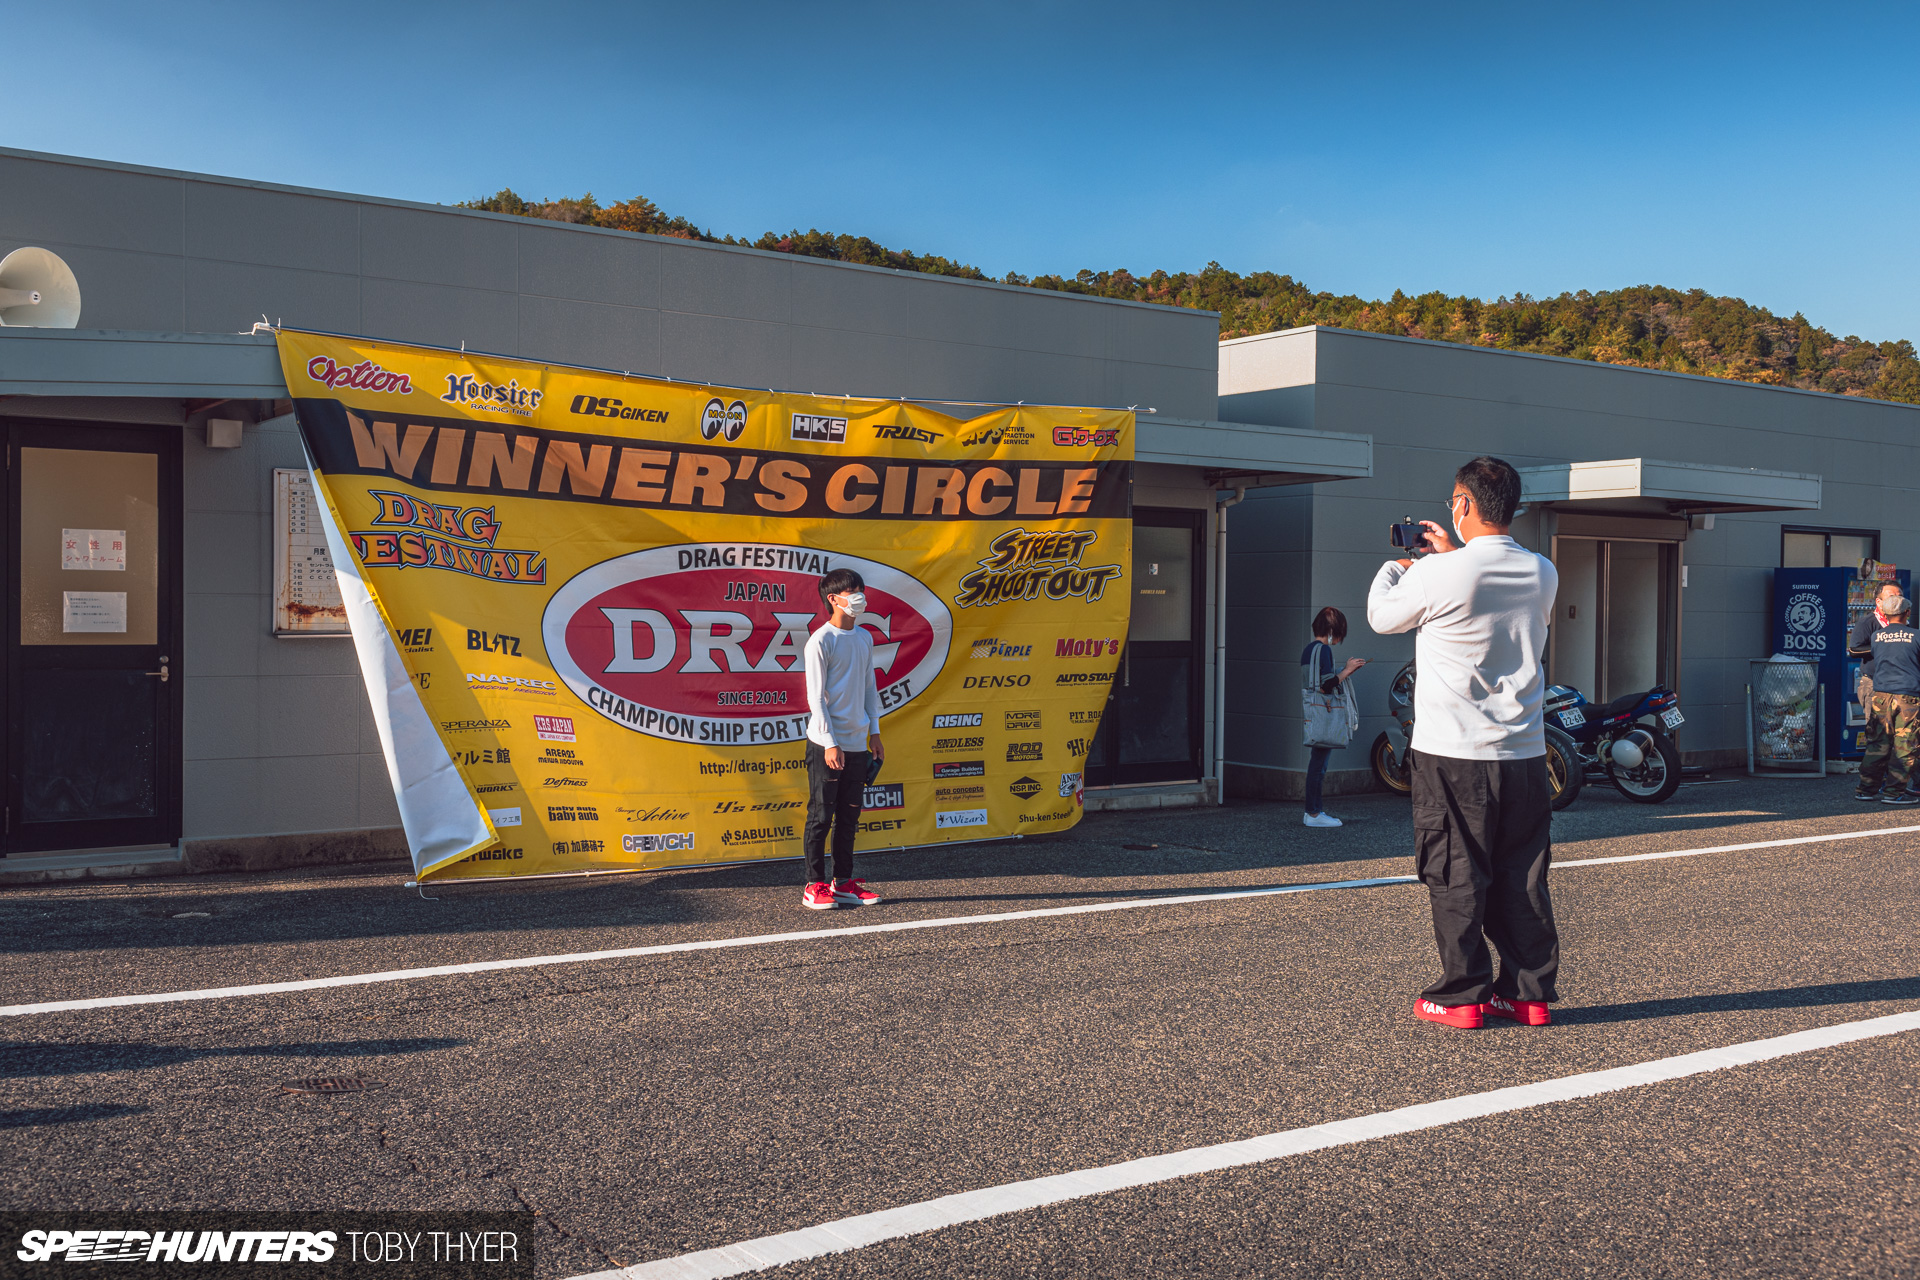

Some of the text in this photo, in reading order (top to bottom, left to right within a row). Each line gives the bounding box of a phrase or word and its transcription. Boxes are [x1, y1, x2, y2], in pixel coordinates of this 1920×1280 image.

[307, 354, 414, 395] Option
[439, 372, 544, 409] Hoosier
[470, 402, 533, 418] RACING TIRE
[570, 394, 669, 424] OS GIKEN
[708, 409, 743, 420] MOON
[793, 415, 847, 438] HKS
[872, 424, 944, 445] TRUST
[346, 410, 1099, 516] WINNER'S CIRCLE
[370, 490, 501, 546] DRAG
[65, 539, 123, 551] 女性用
[979, 528, 1096, 569] STREET
[65, 555, 123, 563] シャワールーム
[677, 547, 829, 575] DRAG FESTIVAL
[723, 581, 787, 603] JAPAN
[1789, 592, 1823, 606] COFFEE
[395, 628, 432, 646] MEI
[598, 607, 902, 676] DRAG
[971, 638, 999, 648] ROYAL
[1783, 634, 1827, 650] BOSS
[1875, 630, 1915, 643] Hoosier
[1055, 637, 1119, 657] Moty's
[466, 673, 556, 691] NAPREC
[962, 674, 1031, 689] DENSO
[1056, 673, 1088, 683] AUTO
[717, 691, 788, 706] SINCE 2014
[587, 686, 695, 740] CHAMPION
[699, 721, 745, 743] SHIP
[750, 719, 787, 742] FOR
[878, 678, 912, 709] EST
[1006, 712, 1040, 720] MORE
[1069, 711, 1085, 720] PIT
[441, 719, 512, 731] SPERANZA
[535, 717, 573, 733] KRS JAPAN
[934, 713, 982, 728] RISING
[1006, 721, 1040, 729] DRIVE
[935, 736, 984, 749] ENDLESS
[1007, 742, 1043, 754] ROD
[476, 784, 517, 794] WORKS
[542, 776, 588, 788] Deftness
[1028, 783, 1043, 791] INC.
[935, 786, 984, 796] auto concepts
[862, 791, 902, 808] UCHI
[627, 806, 690, 822] Active
[713, 801, 803, 814] Y's style
[548, 811, 599, 822] baby auto
[945, 813, 986, 824] Wizard
[1018, 813, 1051, 823] Shu-ken
[734, 826, 794, 841] SABULIVE
